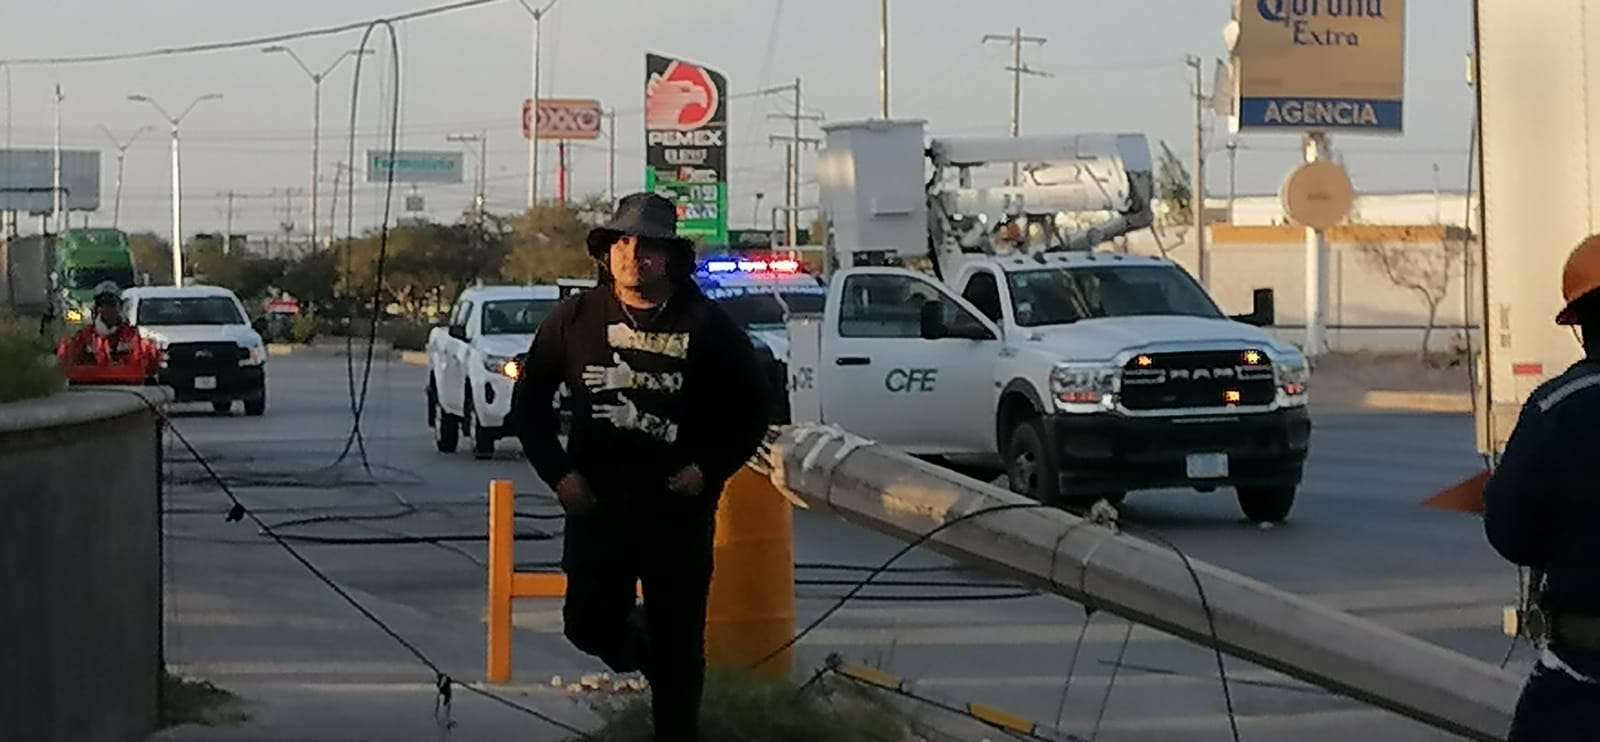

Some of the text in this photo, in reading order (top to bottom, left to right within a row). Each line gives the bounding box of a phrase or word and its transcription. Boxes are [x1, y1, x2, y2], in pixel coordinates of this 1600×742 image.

[1293, 20, 1359, 46] Extra
[523, 107, 600, 131] OXXO
[1264, 100, 1378, 125] AGENCIA
[648, 129, 723, 147] PEMEX
[885, 368, 938, 392] CFE
[1169, 367, 1235, 380] RAM
